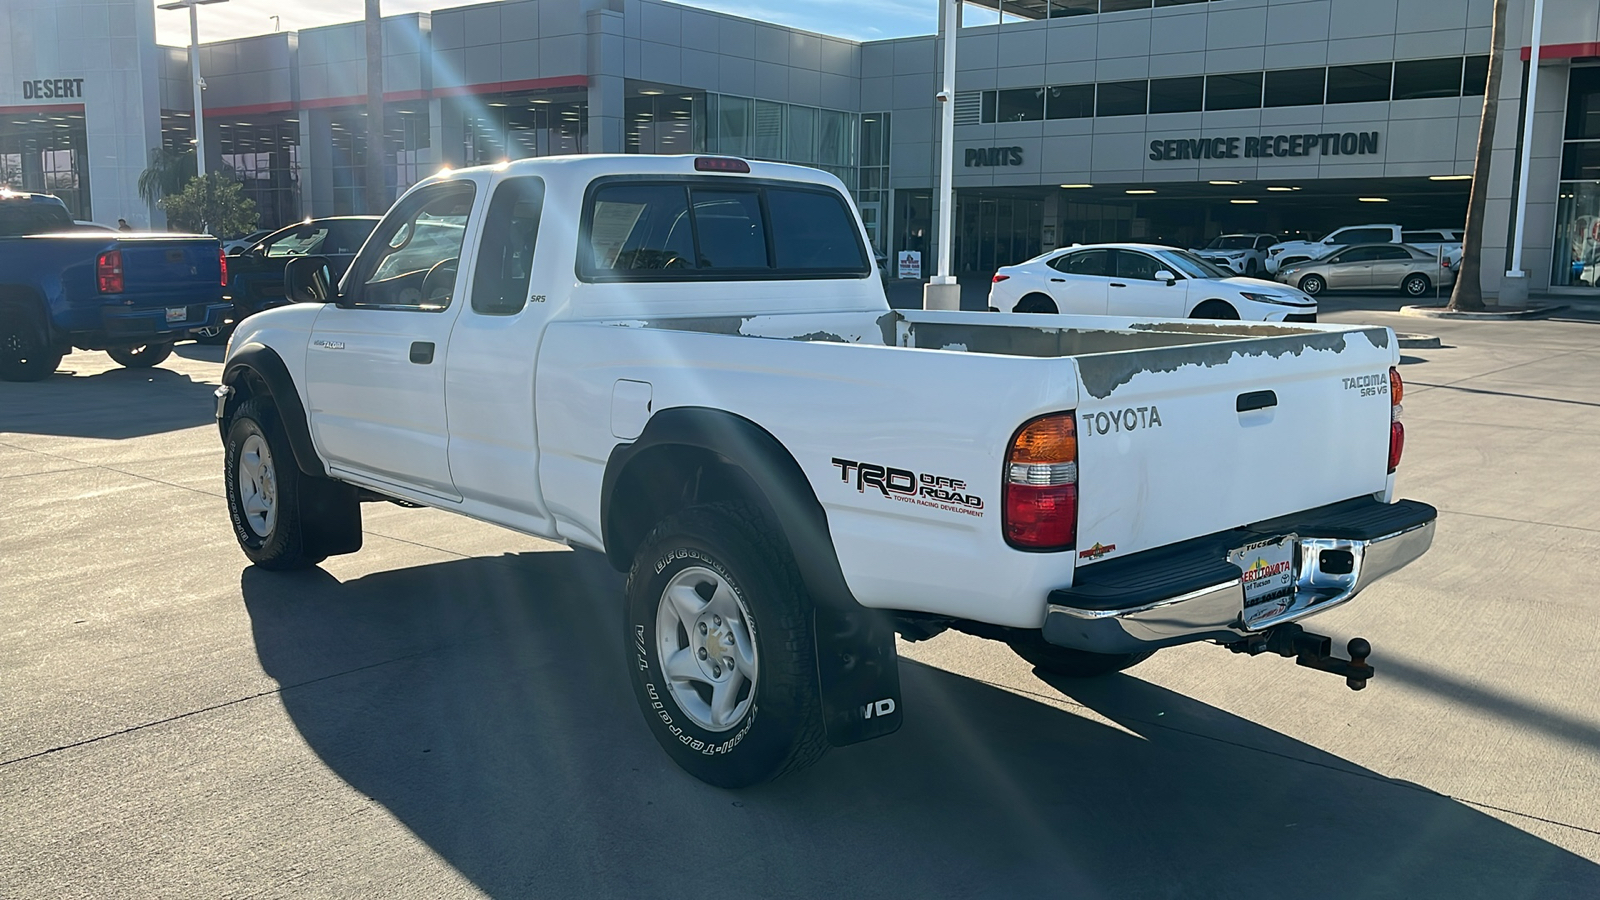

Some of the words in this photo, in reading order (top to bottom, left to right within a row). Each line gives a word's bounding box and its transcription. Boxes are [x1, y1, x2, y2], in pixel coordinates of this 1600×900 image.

[23, 78, 84, 99] DESERT
[965, 147, 1023, 167] PARTS
[1149, 138, 1239, 161] SERVICE
[1244, 132, 1378, 158] RECEPTION
[1342, 373, 1387, 390] TACOMA
[1082, 405, 1162, 437] TOYOTA
[832, 457, 918, 499] TRD
[919, 473, 967, 491] OFF
[893, 494, 916, 504] TOYOTA
[916, 499, 939, 509] RACING
[940, 504, 984, 518] DEVELOPMENT
[919, 486, 984, 509] ROAD
[1260, 560, 1290, 578] TOYOTA
[1253, 579, 1271, 588] Tucson
